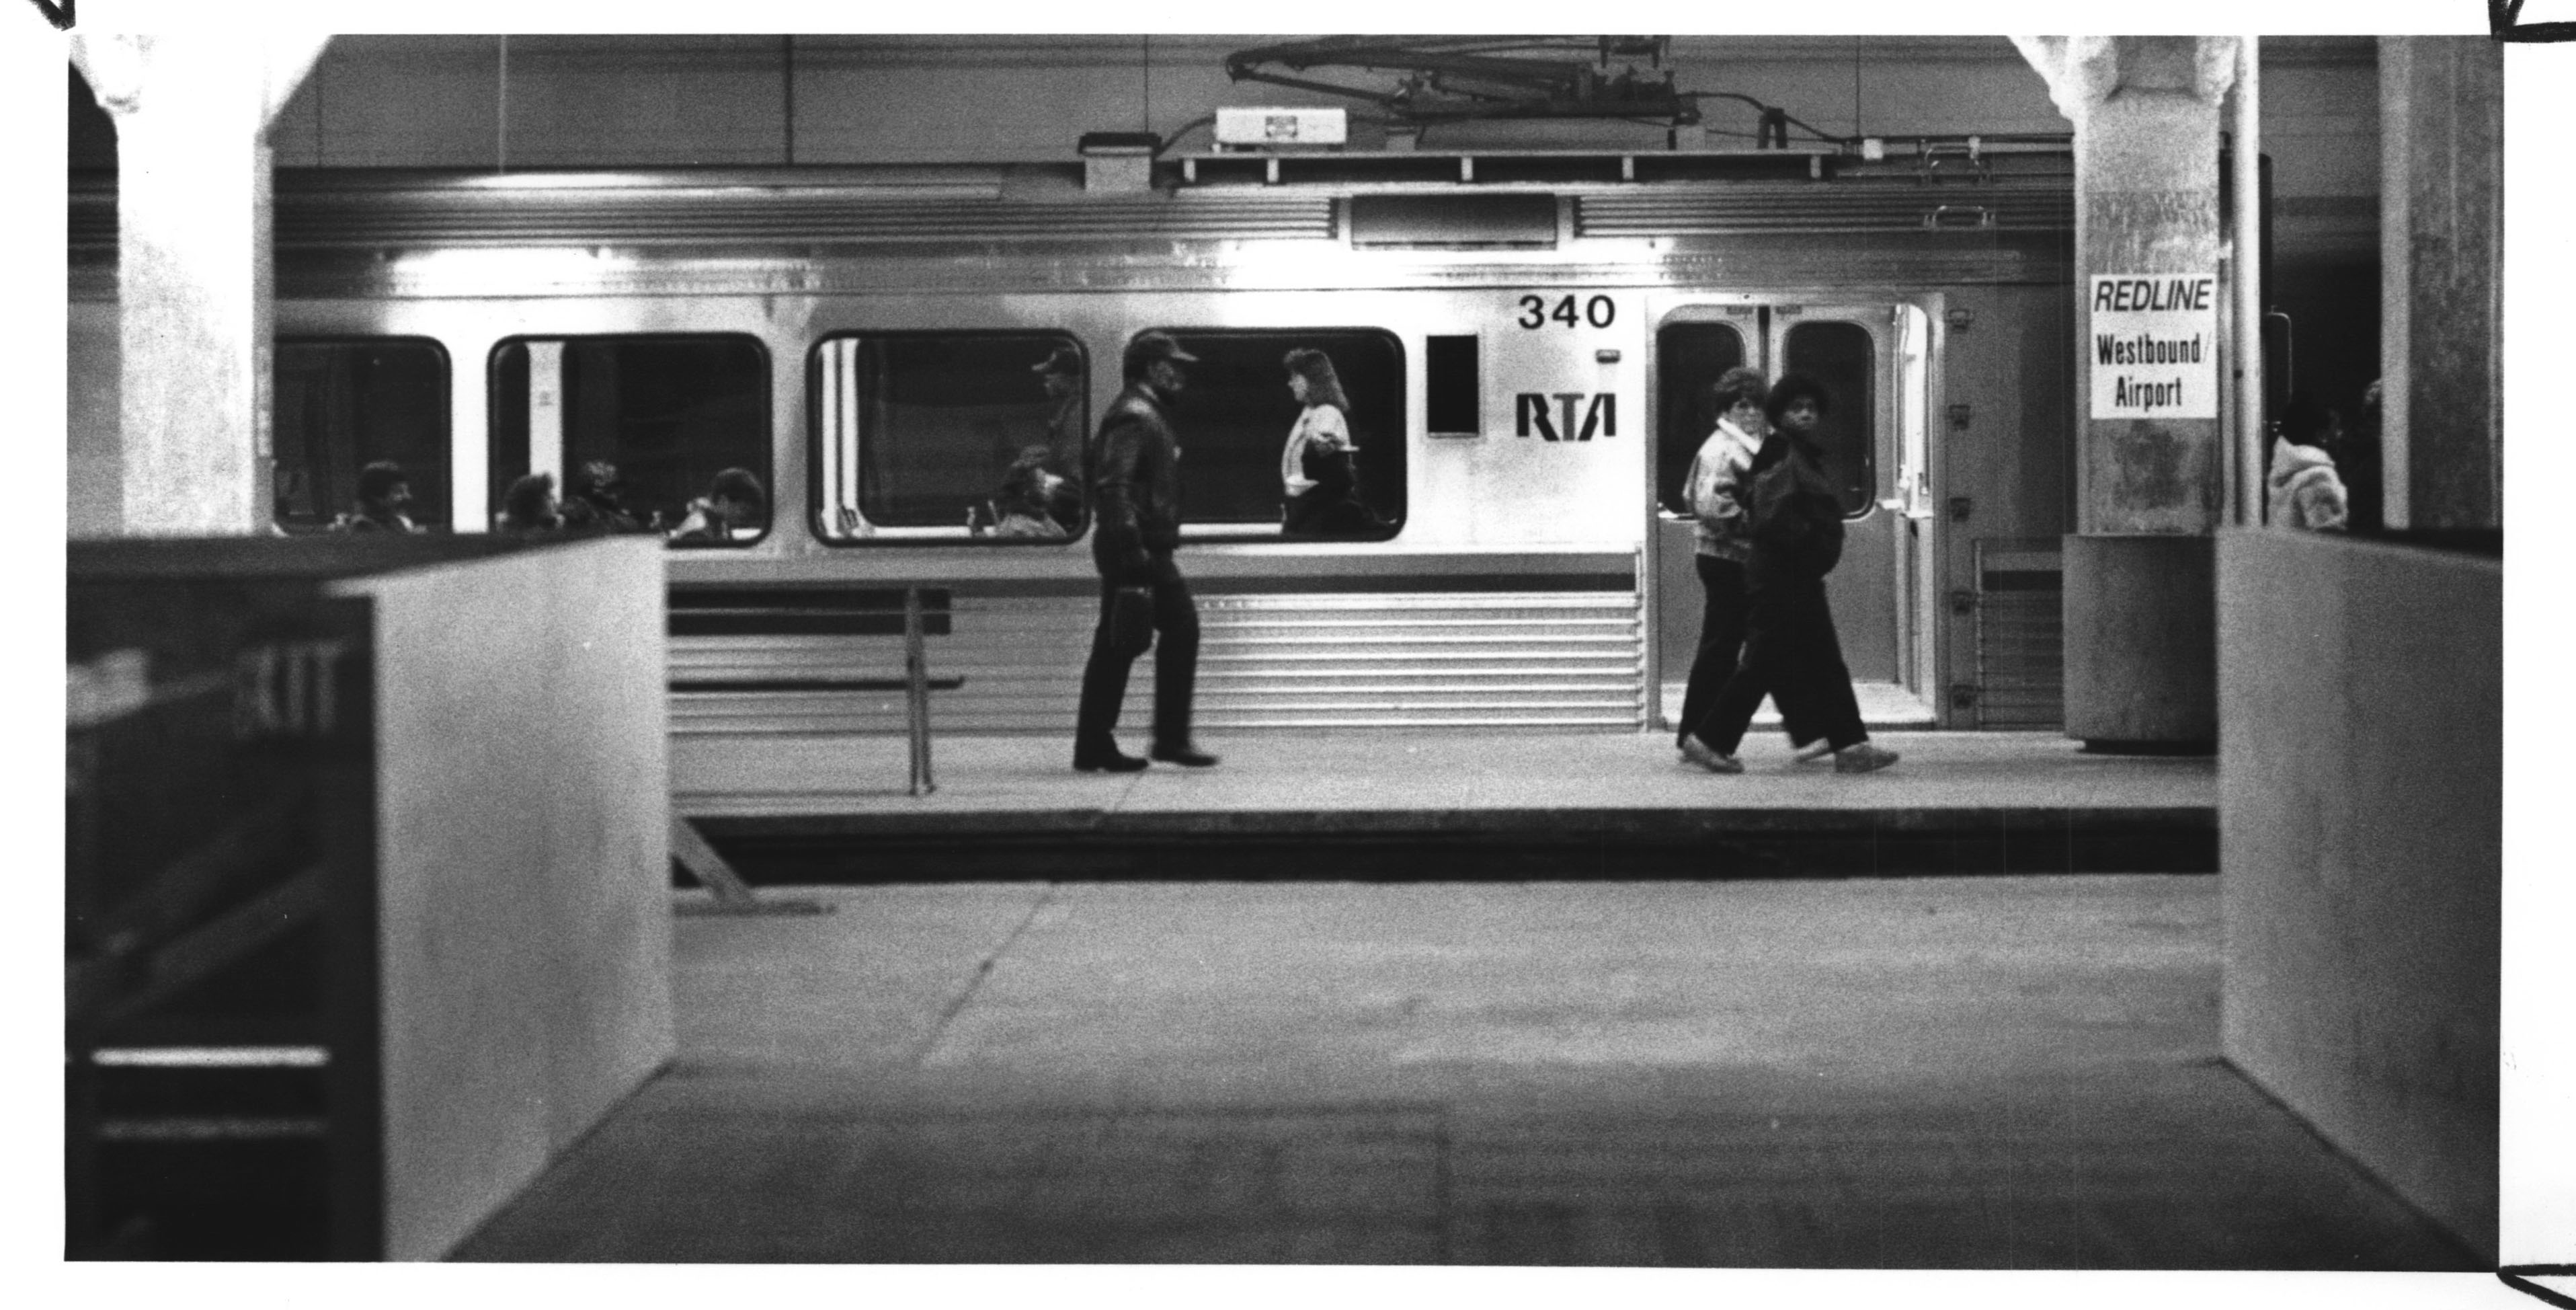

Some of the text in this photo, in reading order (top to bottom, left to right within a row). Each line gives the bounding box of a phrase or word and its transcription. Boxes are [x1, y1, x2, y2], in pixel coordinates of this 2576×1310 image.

[1518, 294, 1615, 330] 340
[2095, 279, 2212, 311] REDLINE
[2116, 376, 2181, 412] Airport
[1517, 393, 1616, 441] RTA
